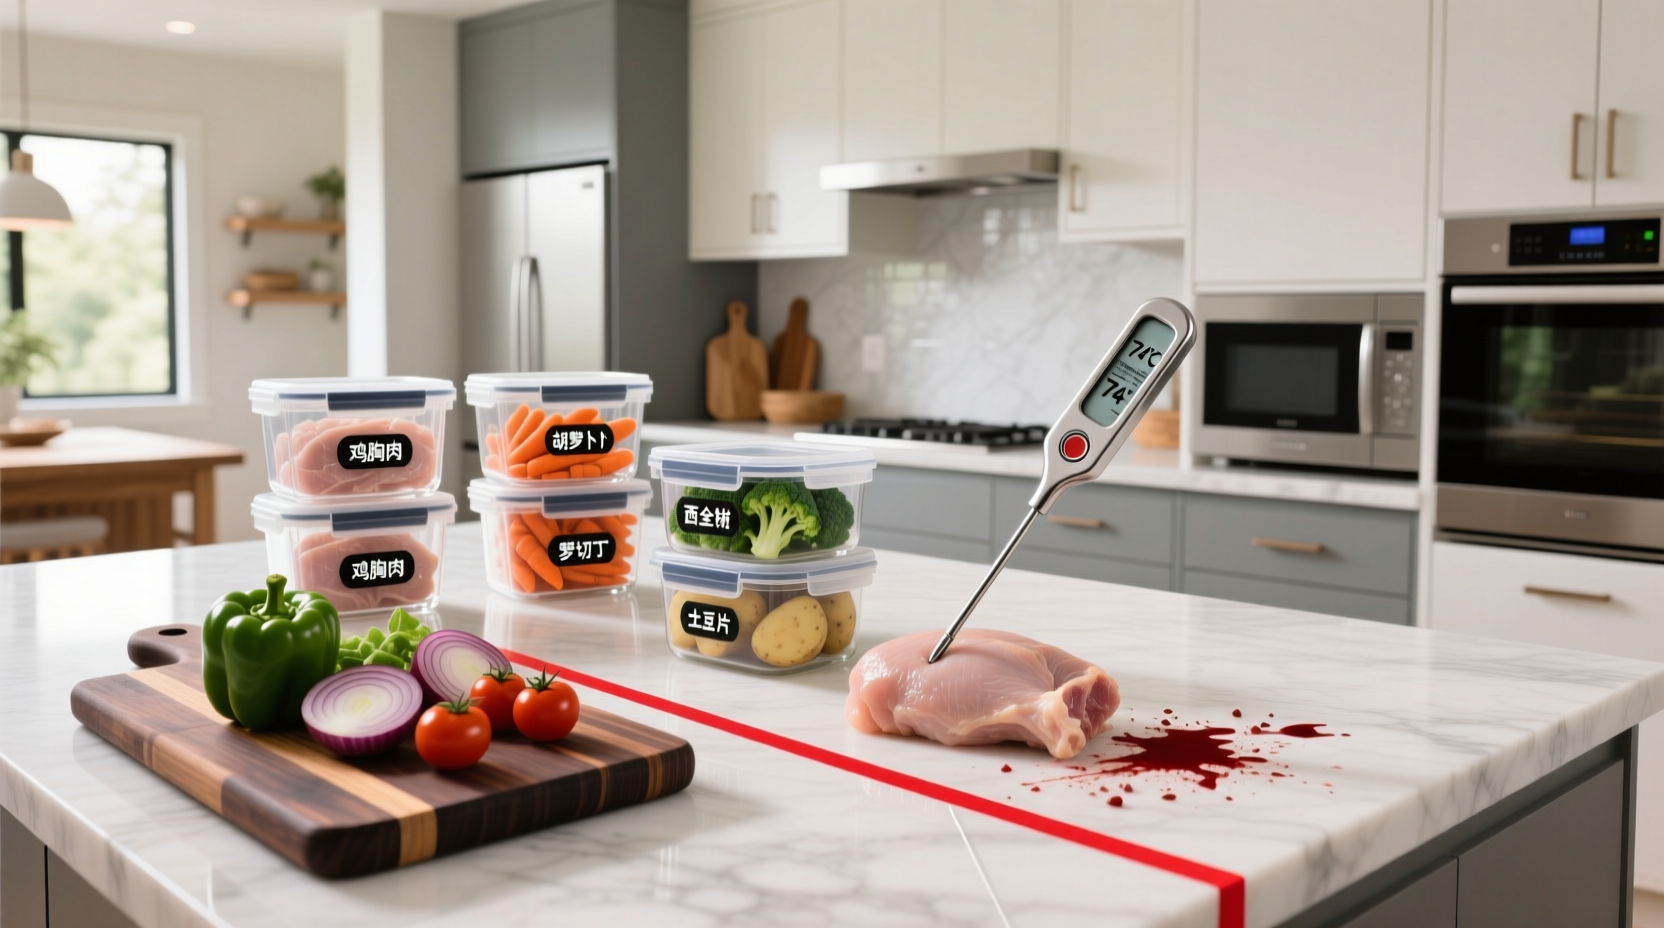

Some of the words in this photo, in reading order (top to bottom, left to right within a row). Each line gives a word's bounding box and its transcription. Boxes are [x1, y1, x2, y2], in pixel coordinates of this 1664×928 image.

[349, 439, 402, 463] 鸡胸肉
[351, 558, 405, 580] 鸡胸肉
[687, 607, 731, 635] 土豆片
